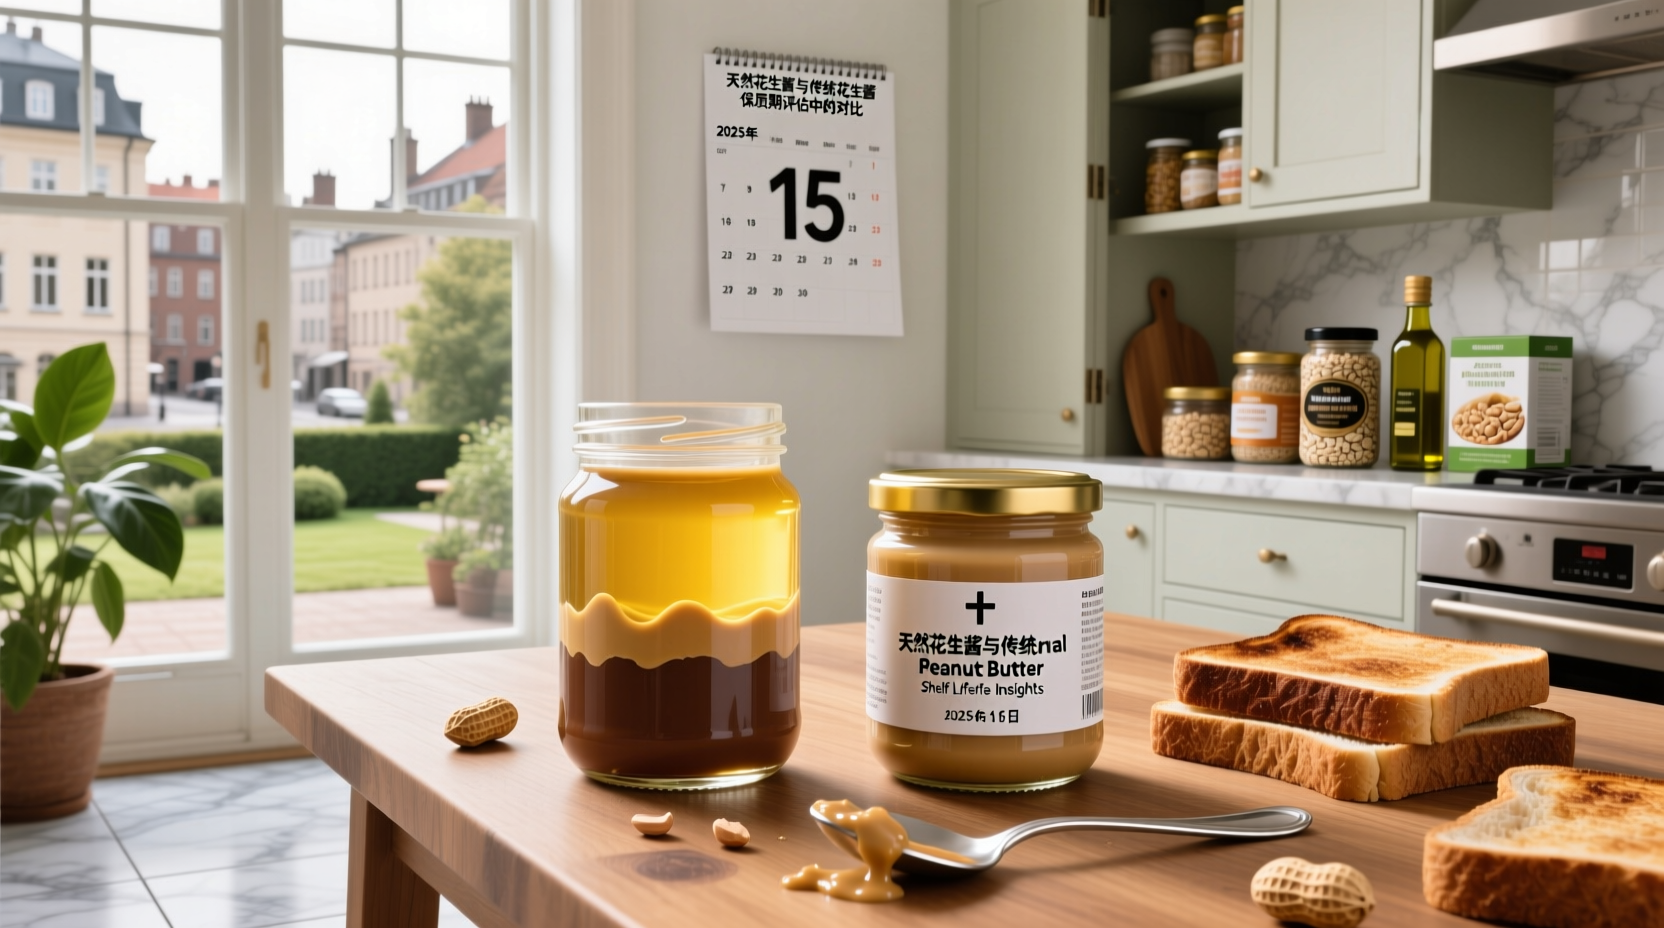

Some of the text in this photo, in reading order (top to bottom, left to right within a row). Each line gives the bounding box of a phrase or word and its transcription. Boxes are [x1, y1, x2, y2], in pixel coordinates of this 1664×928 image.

[716, 125, 759, 141] 2025年
[770, 168, 844, 242] 15
[919, 658, 1044, 677] Peanut Butter
[920, 681, 950, 694] Shelf
[996, 682, 1045, 698] Insights
